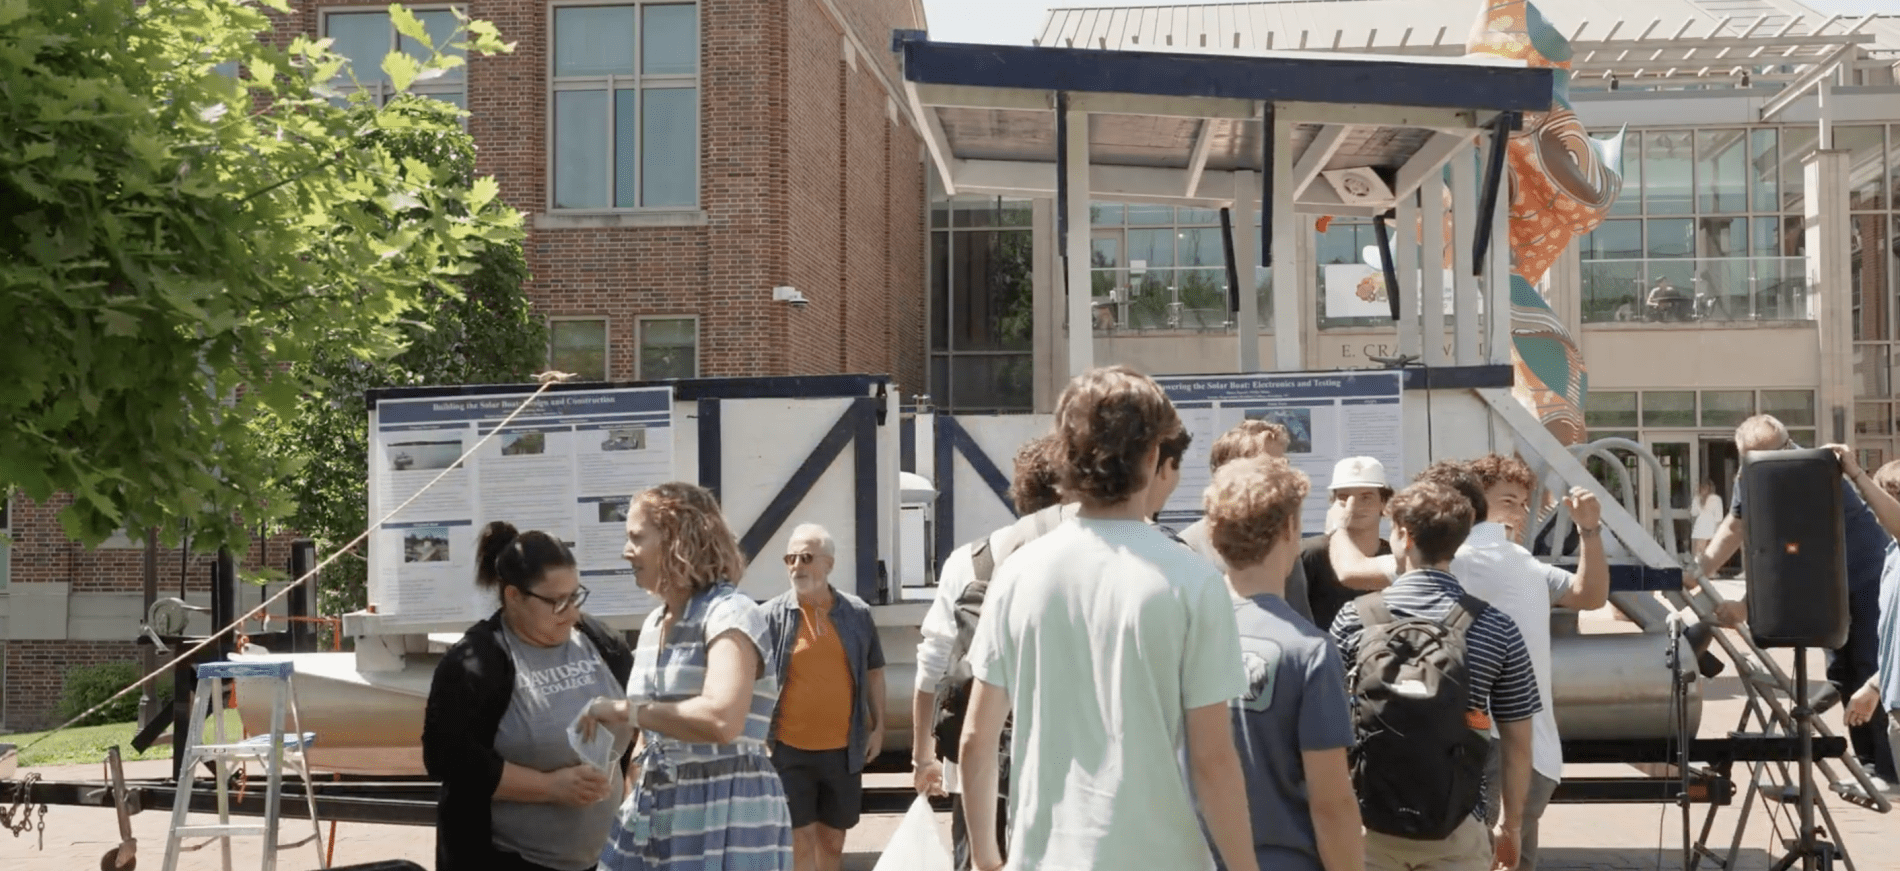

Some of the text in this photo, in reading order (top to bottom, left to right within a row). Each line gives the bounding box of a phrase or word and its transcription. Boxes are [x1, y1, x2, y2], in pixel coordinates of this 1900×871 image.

[1341, 344, 1356, 358] E.
[1192, 381, 1206, 390] the
[1206, 381, 1228, 390] Solar
[1229, 381, 1251, 389] Boat:
[1252, 380, 1295, 389] Electronics
[1297, 379, 1312, 388] and
[1314, 379, 1341, 388] Testing
[432, 402, 465, 412] Building
[466, 401, 478, 409] the
[480, 400, 500, 409] Solar
[550, 397, 565, 406] and
[566, 395, 616, 406] Construction
[541, 674, 595, 696] COLLEGE
